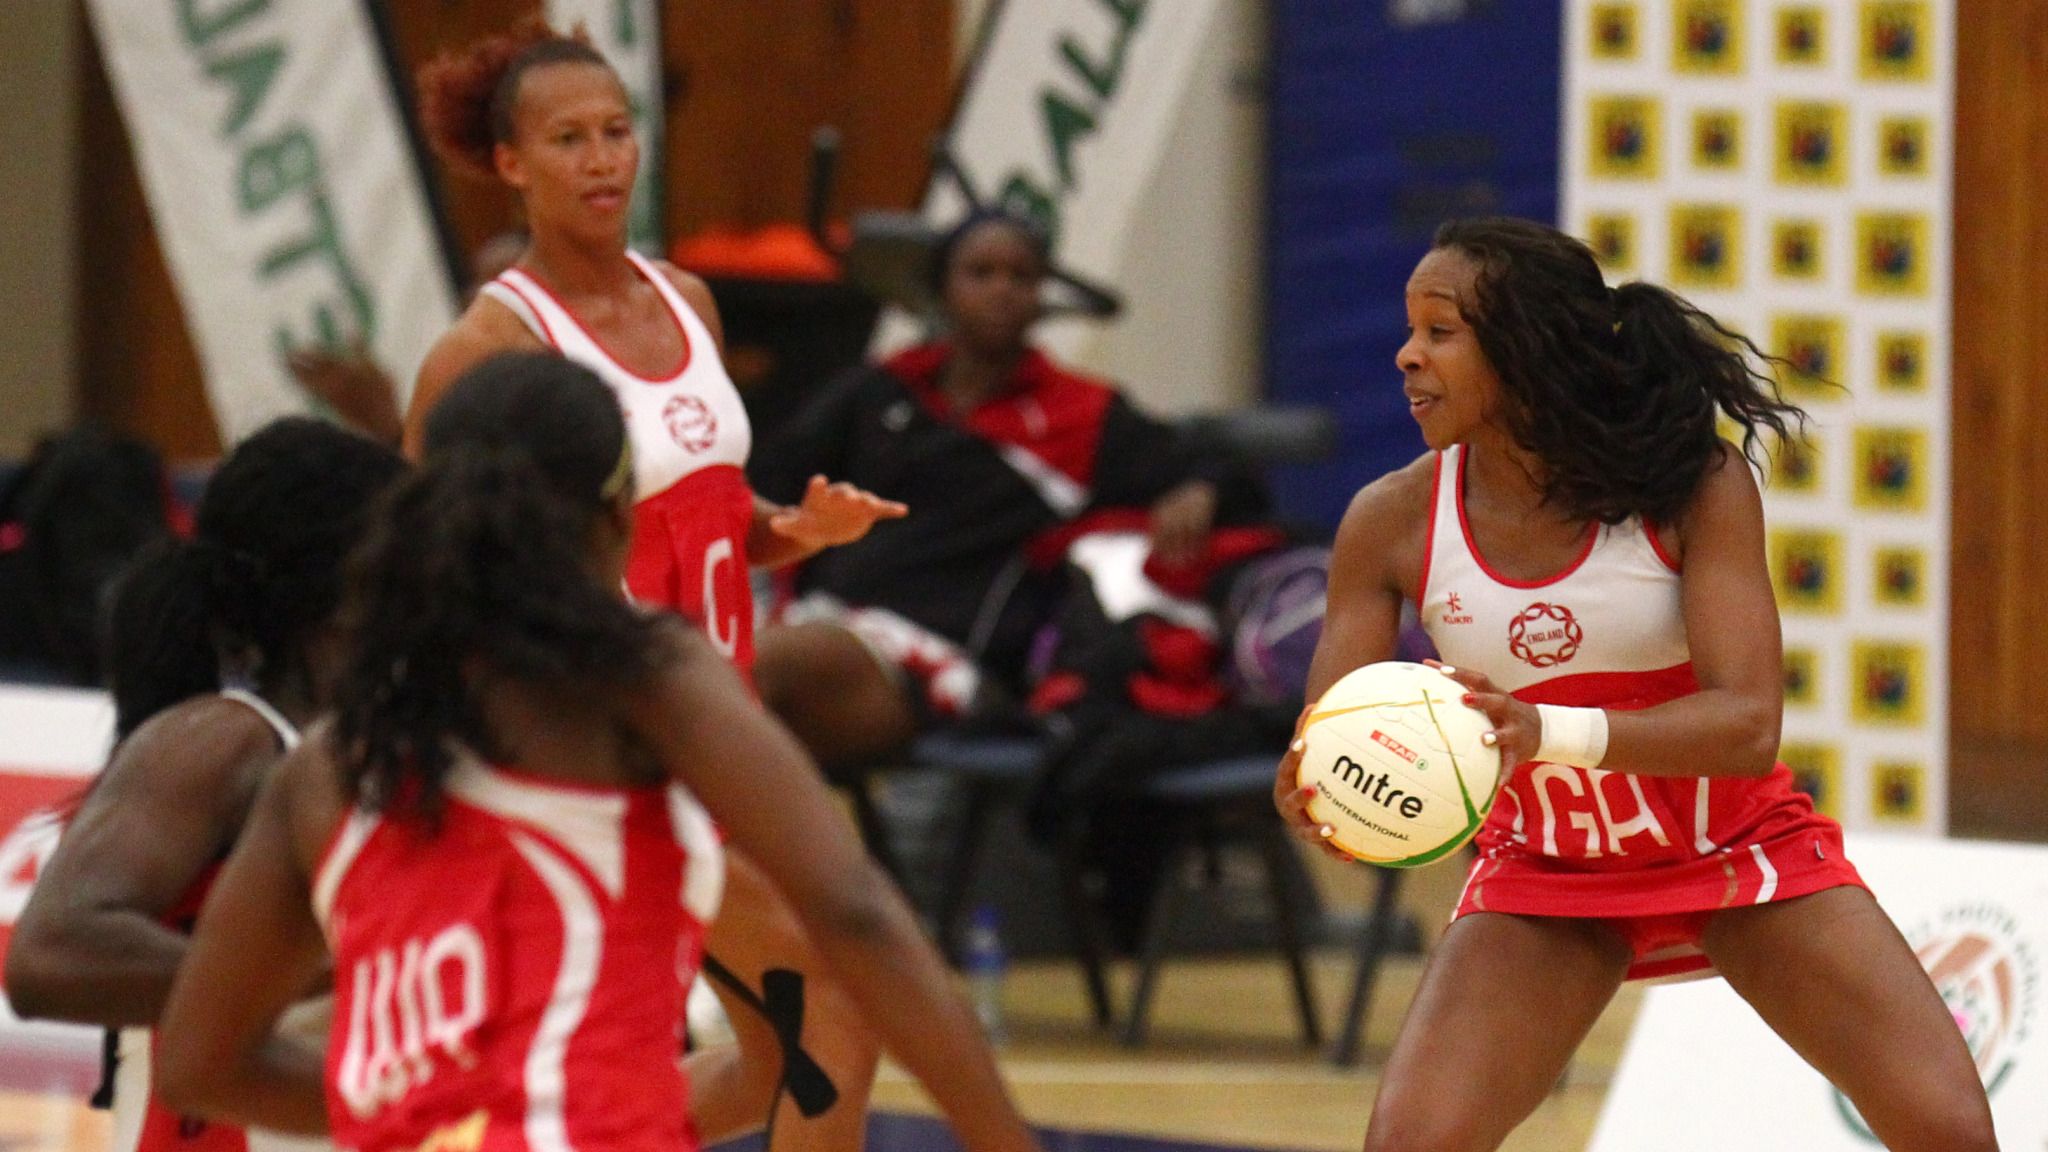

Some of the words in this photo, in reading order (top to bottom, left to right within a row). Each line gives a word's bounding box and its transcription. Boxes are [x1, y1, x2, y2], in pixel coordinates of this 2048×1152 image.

[1527, 628, 1564, 644] ENGLAND
[1316, 780, 1332, 800] PRO
[1332, 798, 1411, 841] INTERNATIONAL
[1332, 755, 1423, 819] mitre
